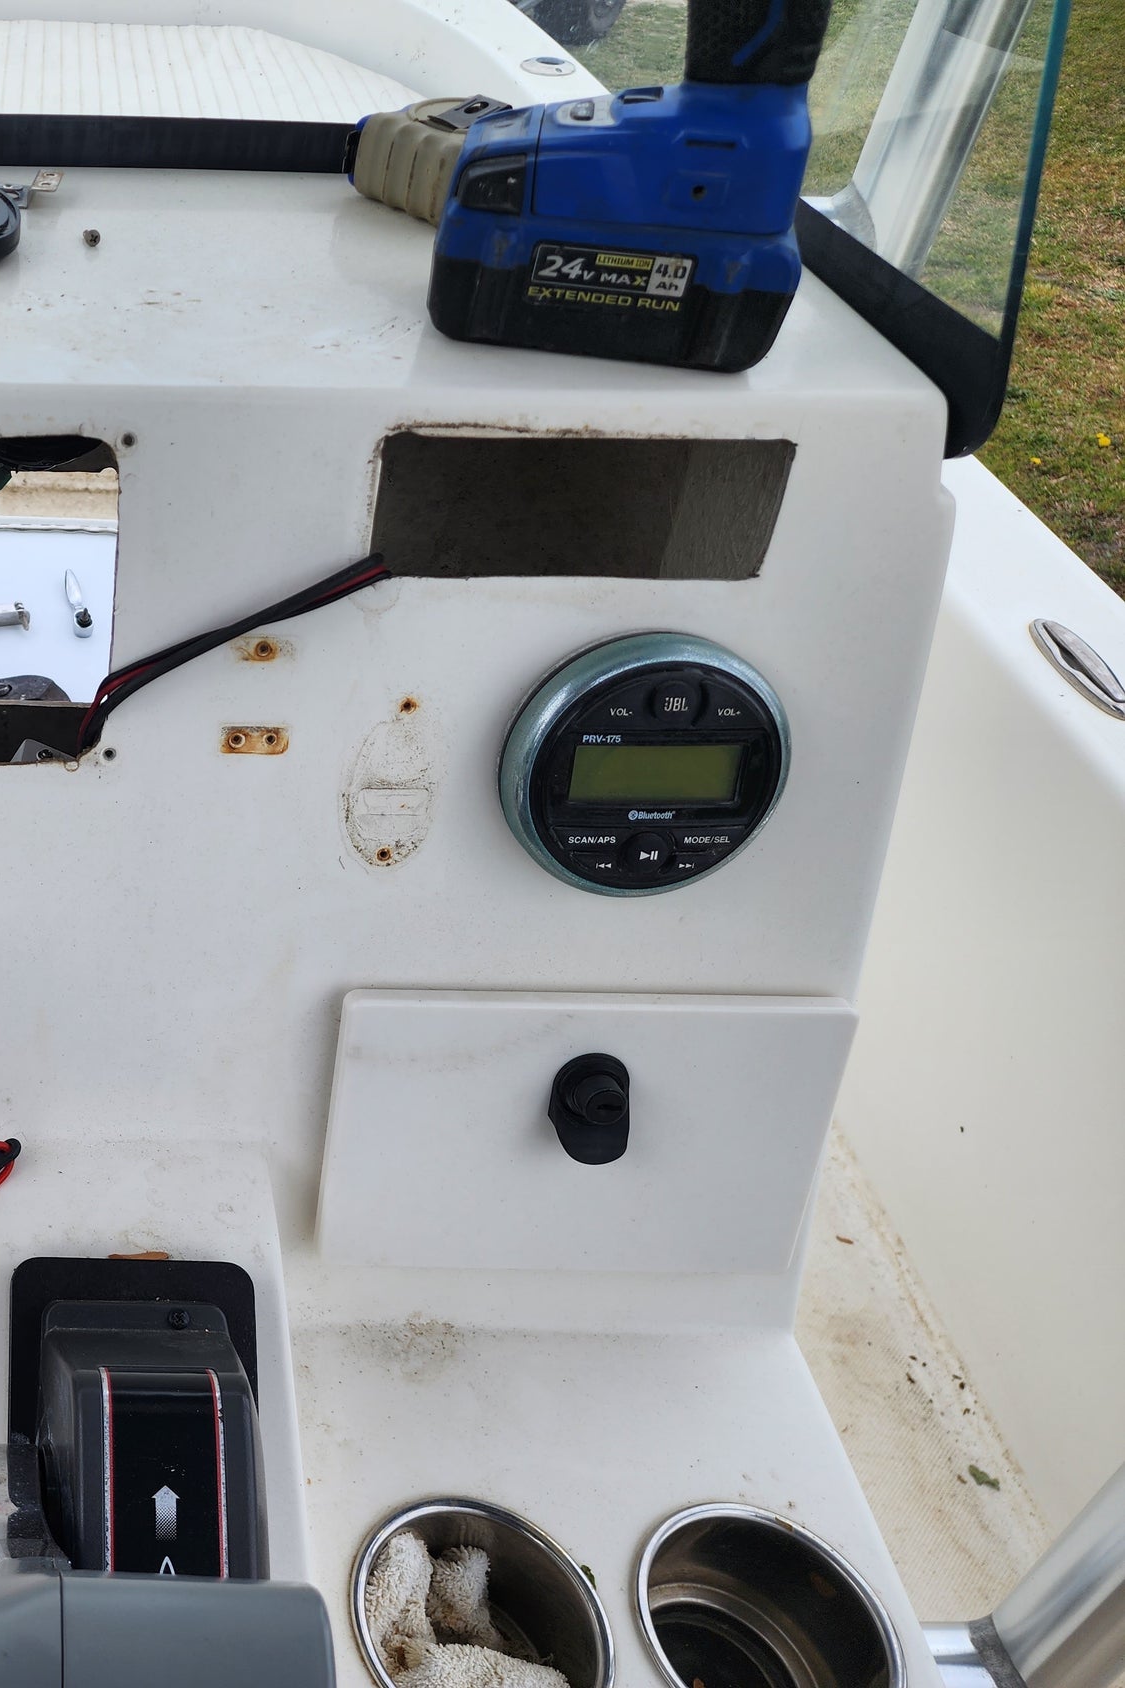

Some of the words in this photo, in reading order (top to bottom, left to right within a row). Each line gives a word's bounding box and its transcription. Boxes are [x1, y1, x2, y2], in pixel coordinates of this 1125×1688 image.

[598, 255, 635, 267] LITHIUM
[635, 258, 651, 269] ION
[655, 262, 688, 280] 4.0
[600, 272, 648, 287] MAX
[655, 281, 679, 291] Ah
[527, 286, 632, 306] EXTENDED
[637, 298, 681, 312] RUN
[664, 697, 688, 712] JBL
[610, 708, 633, 717] VOL-
[717, 708, 741, 717] VOL+
[582, 734, 622, 744] PRV-175
[638, 811, 673, 820] Bluetooth
[568, 836, 616, 845] SCAN/APS
[684, 835, 731, 844] MODE/SEL
